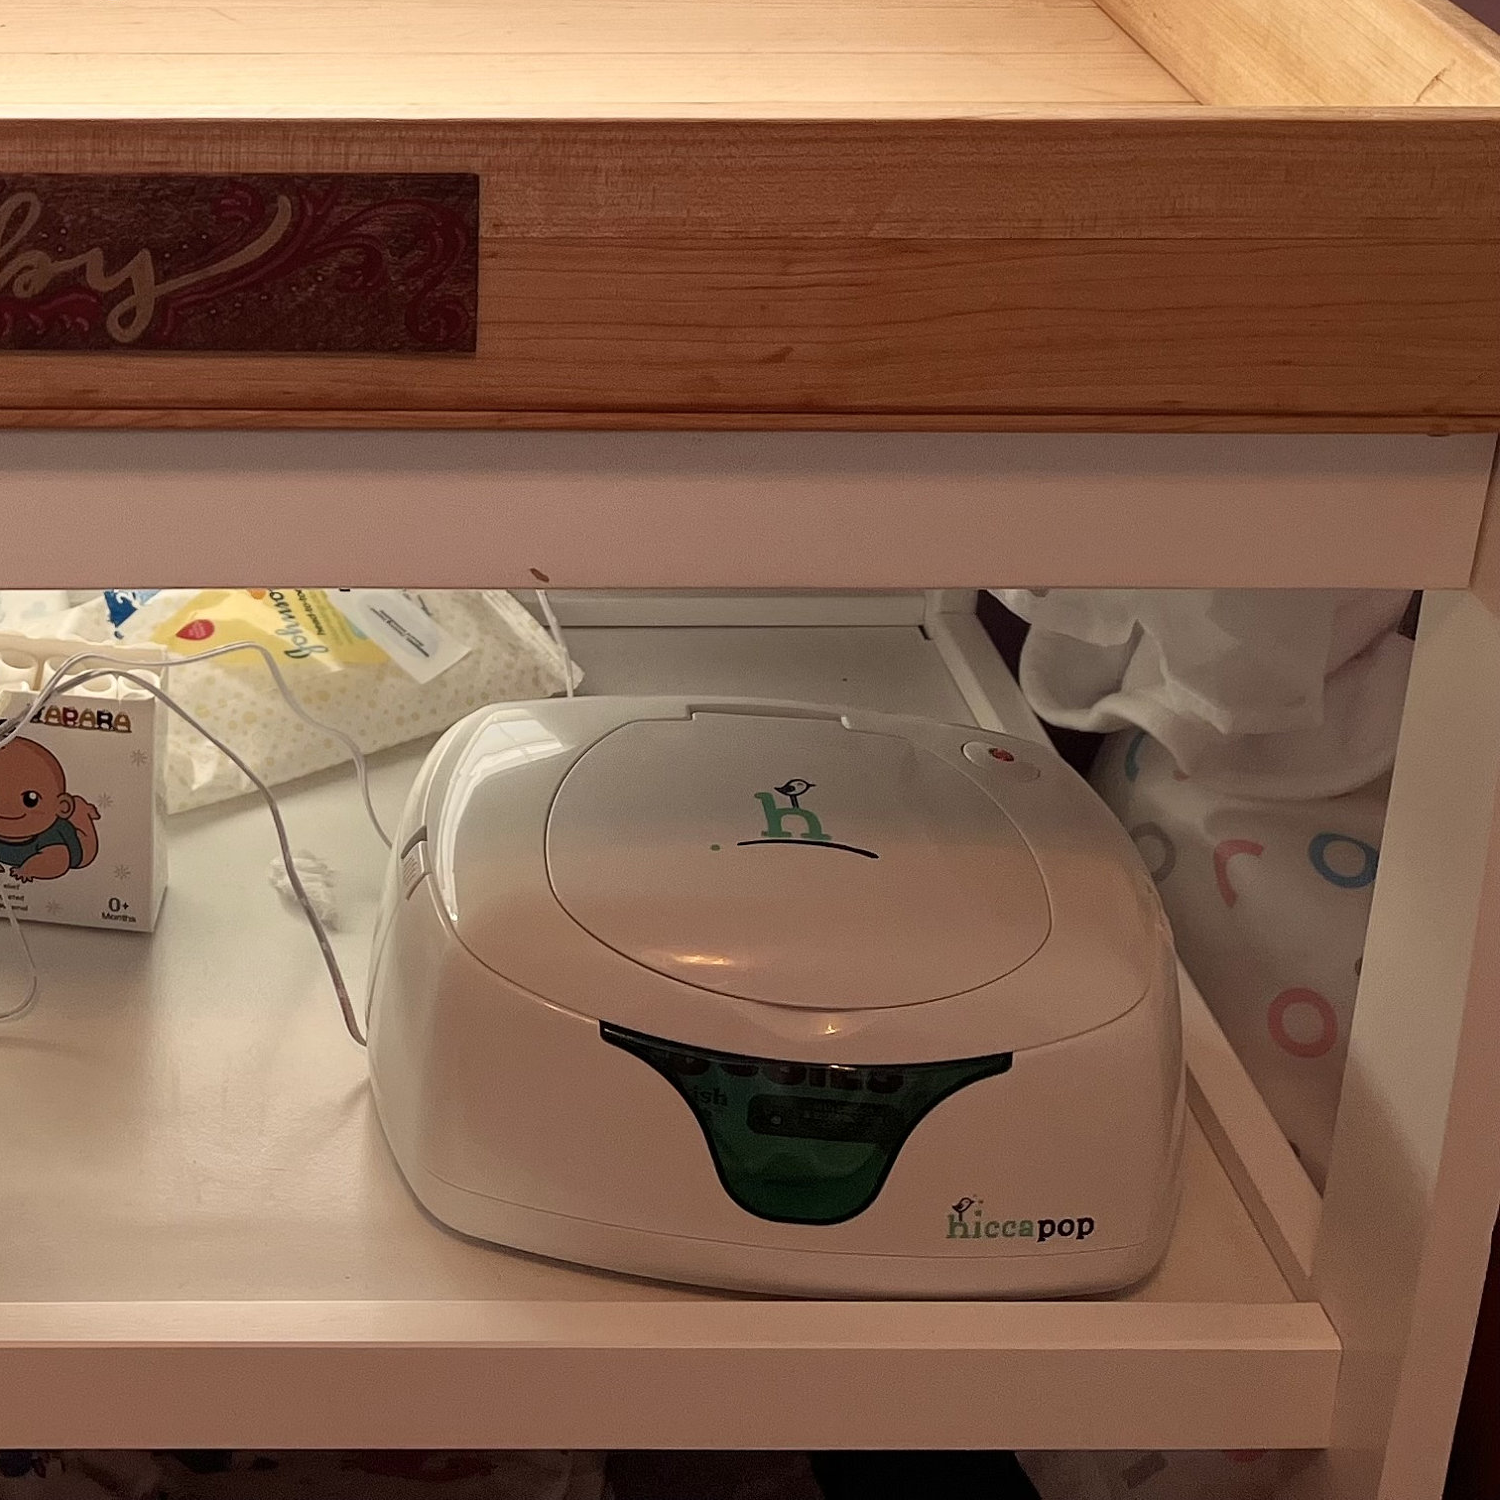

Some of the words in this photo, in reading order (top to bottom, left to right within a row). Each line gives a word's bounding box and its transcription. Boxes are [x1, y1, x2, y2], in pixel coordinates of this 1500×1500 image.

[268, 588, 329, 659] Johnso
[108, 897, 130, 912] 0+
[946, 1208, 1095, 1243] hiccapop
